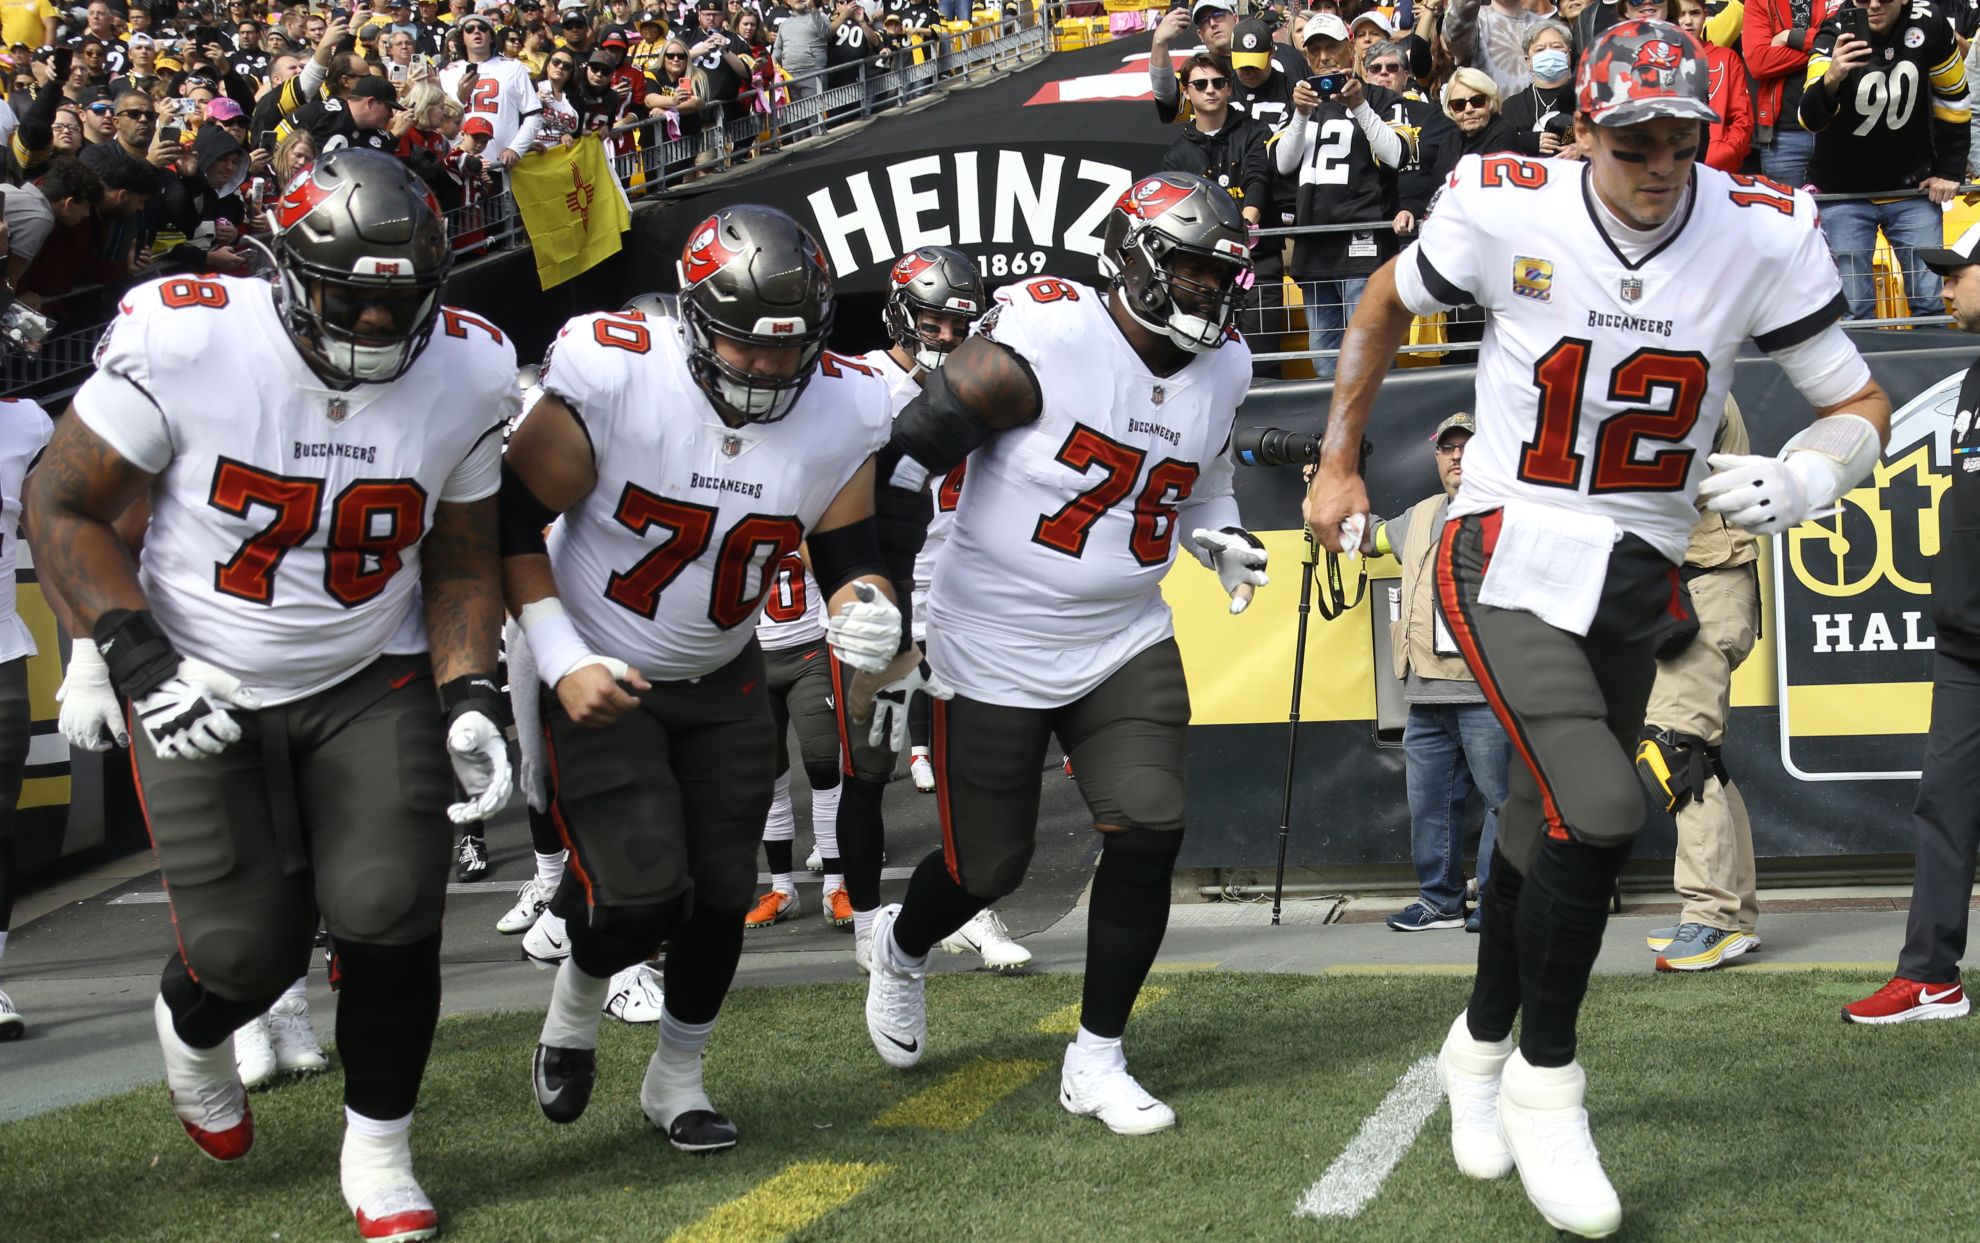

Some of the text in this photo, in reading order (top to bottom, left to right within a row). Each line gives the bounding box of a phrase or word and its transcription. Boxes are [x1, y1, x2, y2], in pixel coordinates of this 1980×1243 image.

[835, 24, 863, 48] 90
[1854, 60, 1919, 136] 90
[1300, 118, 1354, 186] 12
[807, 150, 1132, 279] HEINZ
[977, 251, 1047, 277] 1869
[1588, 310, 1673, 337] BUCCANEERS
[1127, 416, 1181, 447] BUCCANEERS
[1518, 335, 1711, 495] 12
[294, 440, 376, 464] BUCCANEERS
[691, 472, 763, 499] BUCCANEERS
[1031, 422, 1199, 567] 76
[208, 455, 428, 609] 78
[603, 481, 805, 631] 70
[1702, 929, 1725, 948] HOKA
